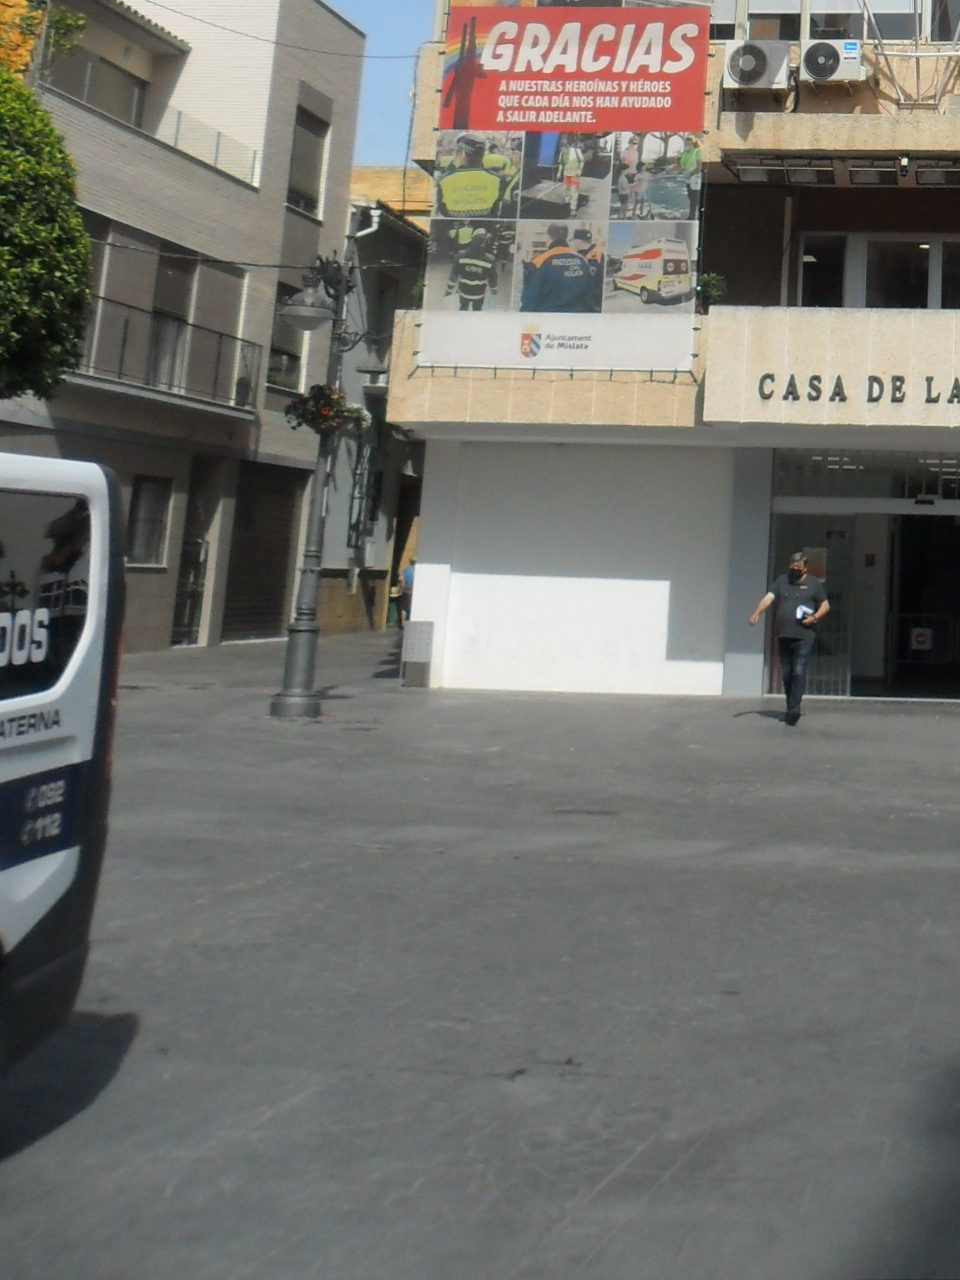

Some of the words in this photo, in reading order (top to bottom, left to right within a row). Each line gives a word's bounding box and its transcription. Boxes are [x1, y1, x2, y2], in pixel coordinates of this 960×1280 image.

[480, 21, 699, 74] GRACIAS
[499, 80, 506, 92] A
[508, 80, 563, 92] NUESTRAS
[565, 78, 619, 93] HEROÍNAS
[620, 81, 628, 93] Y
[629, 78, 671, 93] HÉROES
[498, 95, 520, 108] QUE
[521, 95, 549, 108] CADA
[551, 93, 570, 108] DÍA
[572, 95, 594, 108] NOS
[595, 96, 619, 108] HAN
[620, 96, 672, 108] AYUDADO
[496, 110, 505, 122] A
[506, 110, 537, 122] SALIR
[538, 111, 596, 123] ADELANTE.
[758, 373, 847, 403] CASA
[867, 375, 906, 403] DE
